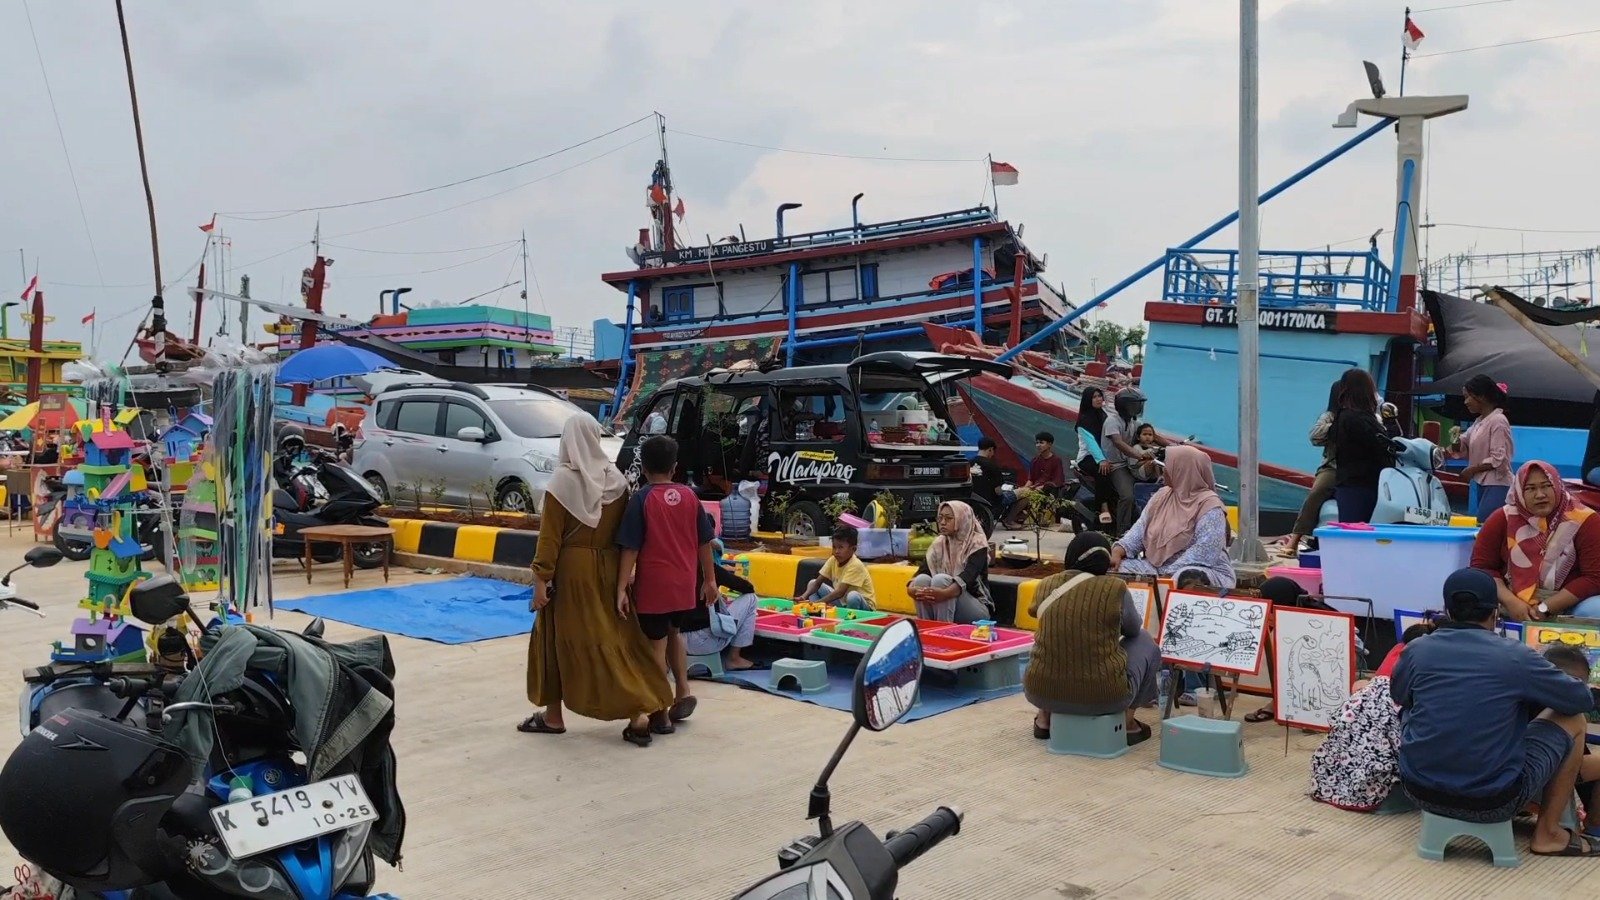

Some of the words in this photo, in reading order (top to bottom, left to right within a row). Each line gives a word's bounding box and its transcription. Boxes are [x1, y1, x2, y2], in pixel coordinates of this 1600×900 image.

[698, 247, 719, 257] MINA
[722, 241, 767, 255] PANGESTU
[1205, 307, 1223, 323] GT.
[768, 451, 857, 485] Mampiro
[1406, 506, 1411, 514] K
[217, 809, 238, 831] K
[250, 790, 312, 819] 5419
[329, 779, 358, 800] YV
